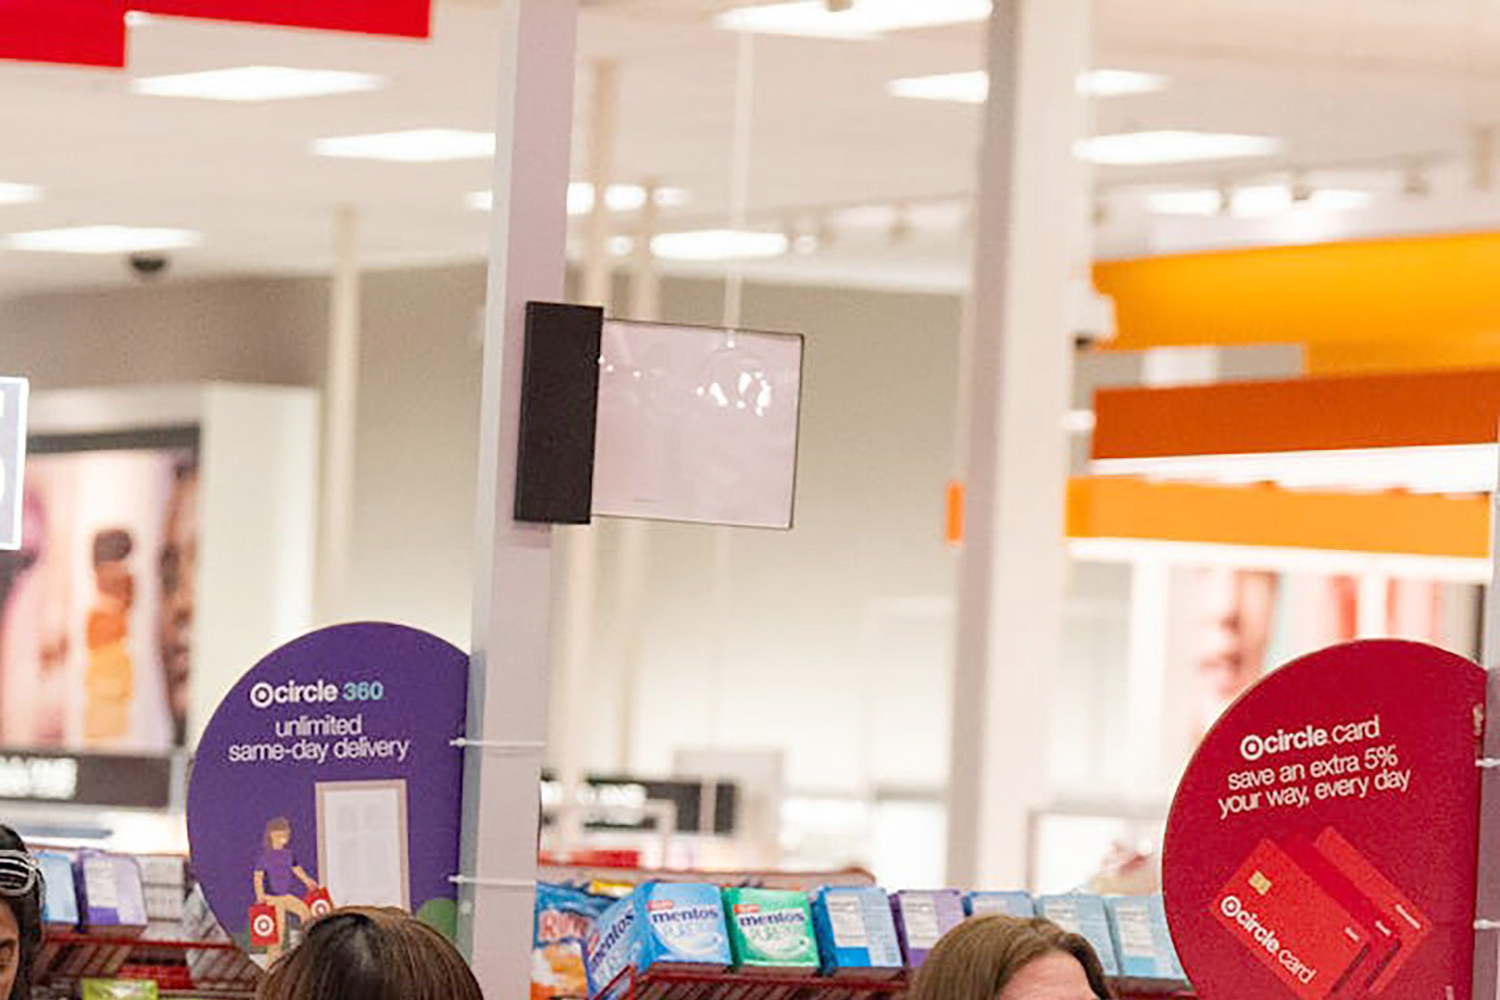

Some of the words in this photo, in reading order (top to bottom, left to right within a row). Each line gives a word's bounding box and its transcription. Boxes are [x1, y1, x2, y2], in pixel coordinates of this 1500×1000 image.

[275, 680, 338, 703] circle
[343, 681, 384, 701] 360
[275, 714, 362, 737] unlimited
[1264, 725, 1327, 754] circle
[1332, 714, 1380, 743] card
[228, 740, 329, 764] same-day
[333, 736, 410, 762] delivery
[1228, 767, 1275, 791] save
[1279, 763, 1305, 783] an
[1310, 754, 1359, 778] extra
[1364, 745, 1398, 770] 5%
[1218, 791, 1261, 820] your
[1265, 784, 1310, 808] way,
[1314, 775, 1369, 800] every
[1374, 768, 1411, 792] day
[652, 907, 719, 924] mentos
[740, 911, 806, 927] mentos
[1236, 913, 1280, 954] circle
[1278, 947, 1317, 985] card
